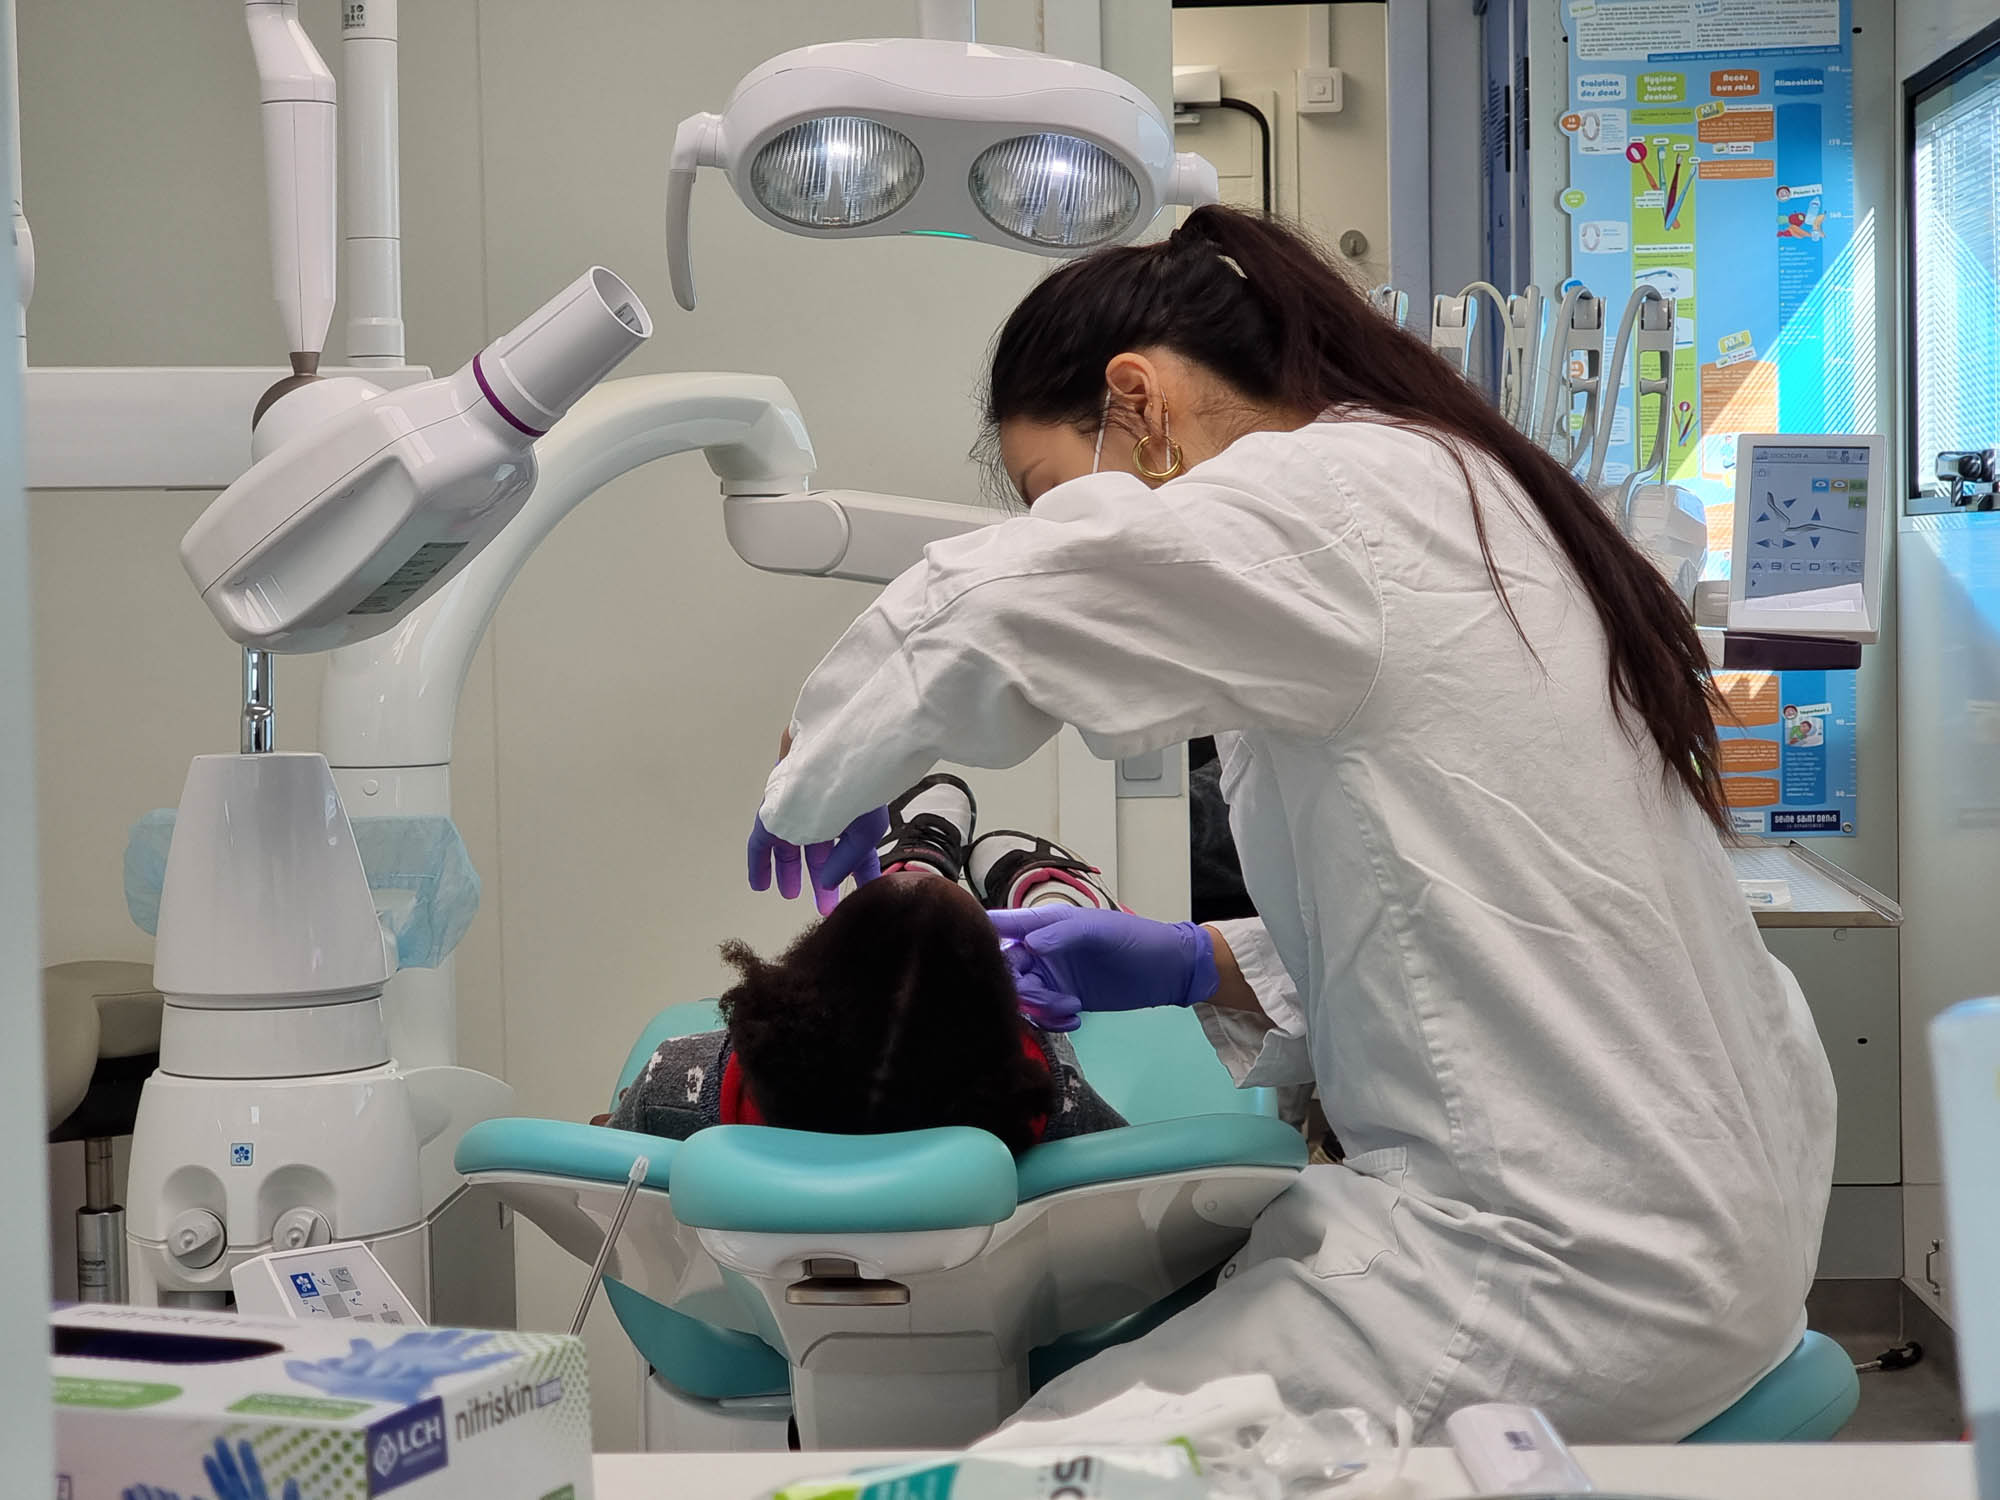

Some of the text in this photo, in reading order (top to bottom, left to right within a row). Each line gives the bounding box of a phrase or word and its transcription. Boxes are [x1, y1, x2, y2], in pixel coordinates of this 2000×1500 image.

[1752, 562, 1821, 571] A B C D
[454, 1380, 535, 1442] nitriskin
[397, 1415, 443, 1454] LCH
